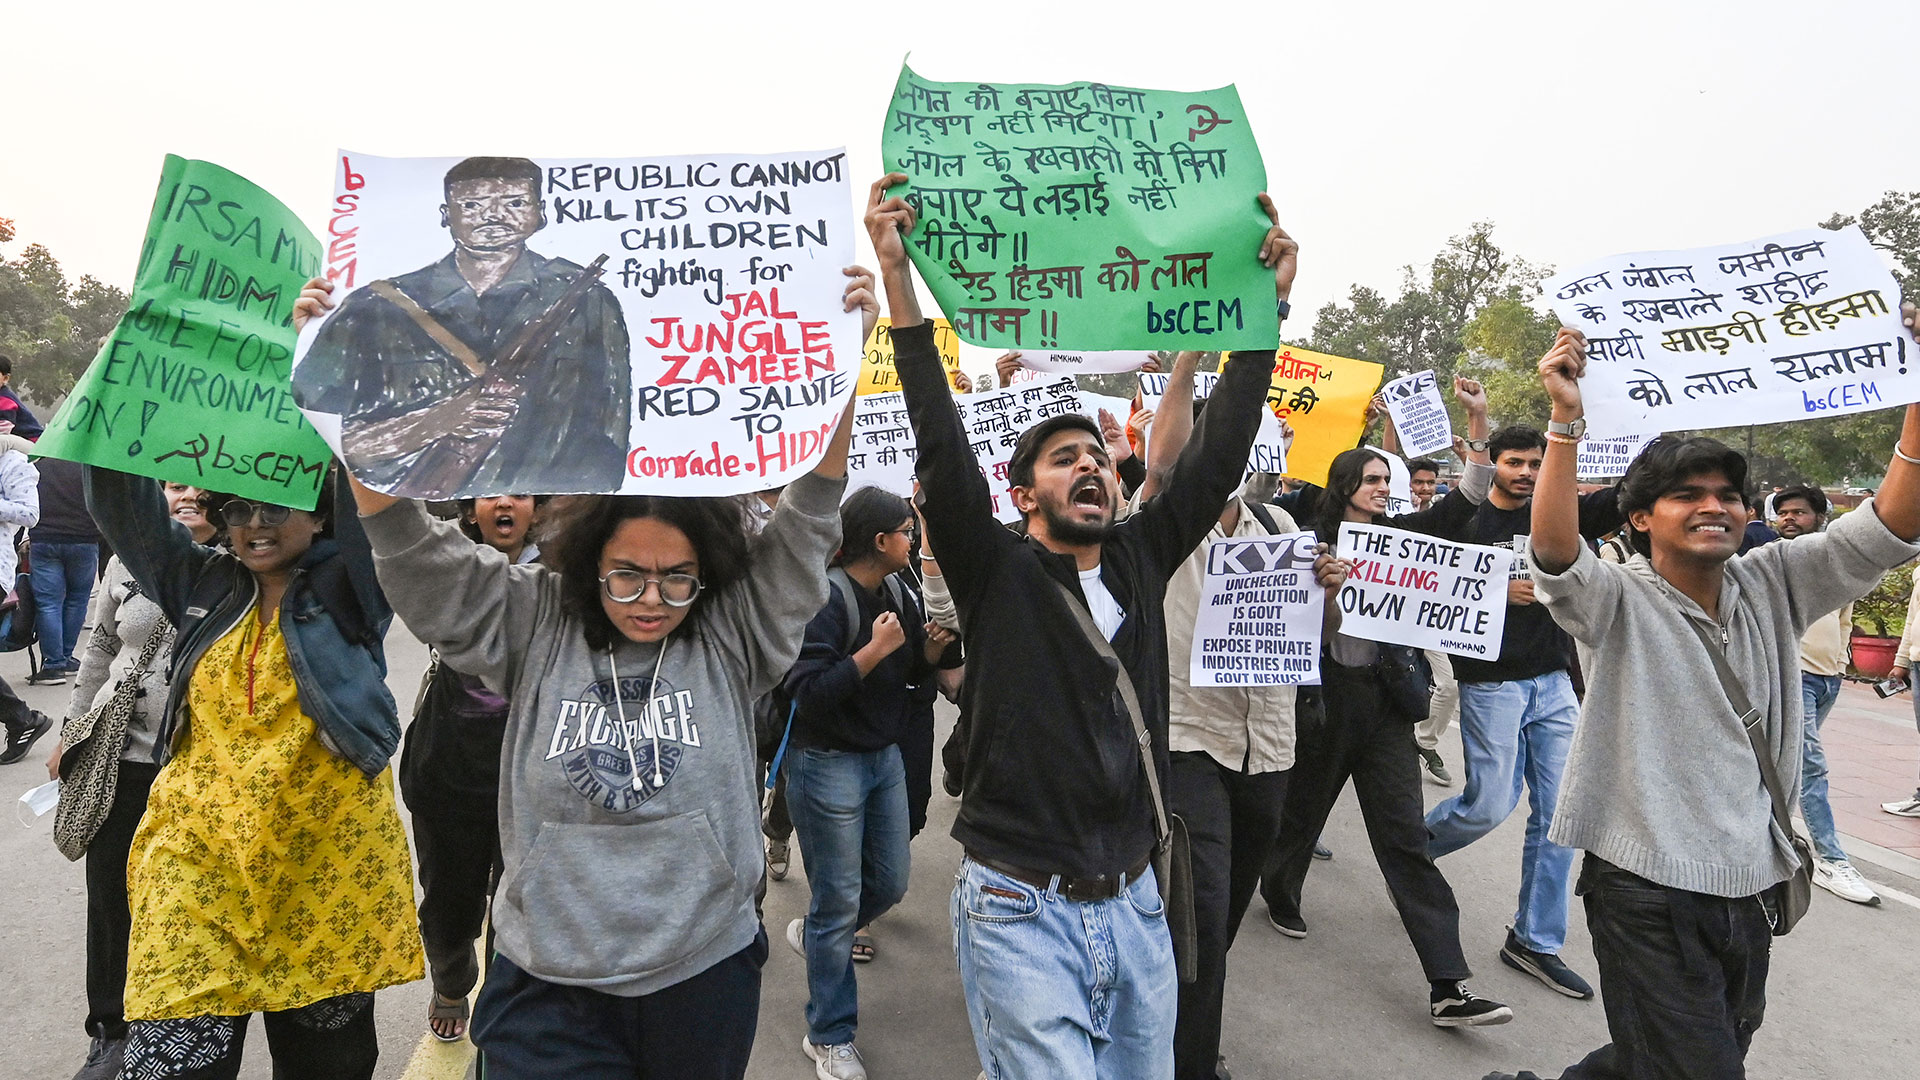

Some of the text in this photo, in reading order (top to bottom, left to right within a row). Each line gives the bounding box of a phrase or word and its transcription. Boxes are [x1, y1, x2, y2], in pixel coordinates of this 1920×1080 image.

[547, 152, 846, 194] REPUBLIC CANNOT
[159, 174, 262, 258] IRSA
[553, 190, 792, 224] KILL ITS OWN
[620, 219, 829, 251] CHILDREN
[617, 256, 794, 306] fighting for
[1556, 271, 1614, 300] जल
[720, 287, 798, 322] JAL
[207, 319, 292, 380] FOR
[645, 316, 834, 355] JUNGLE
[656, 349, 836, 387] ZAMEEN
[638, 370, 849, 421] RED SALUTE
[729, 413, 782, 442] TO
[1586, 442, 1629, 455] WHY NO
[1347, 529, 1393, 557] THE
[1398, 537, 1464, 568] STATE
[1474, 551, 1496, 575] IS
[1226, 573, 1298, 591] UNCHECKED
[1347, 557, 1487, 601] KILLING ITS
[1211, 589, 1309, 606] AIR POLLUTION
[1233, 605, 1283, 620] IS GOVT
[1341, 585, 1490, 636] OWN PEOPLE
[1228, 622, 1287, 637] FAILURE!
[1440, 638, 1487, 655] HIMKHAND
[1202, 655, 1312, 672] INDUSTRIES AND
[1203, 638, 1312, 656] EXPOSE PRIVATE
[1214, 672, 1302, 685] GOVT NEXUS!
[544, 690, 702, 761] EXCHANGE
[566, 752, 602, 801] WITH
